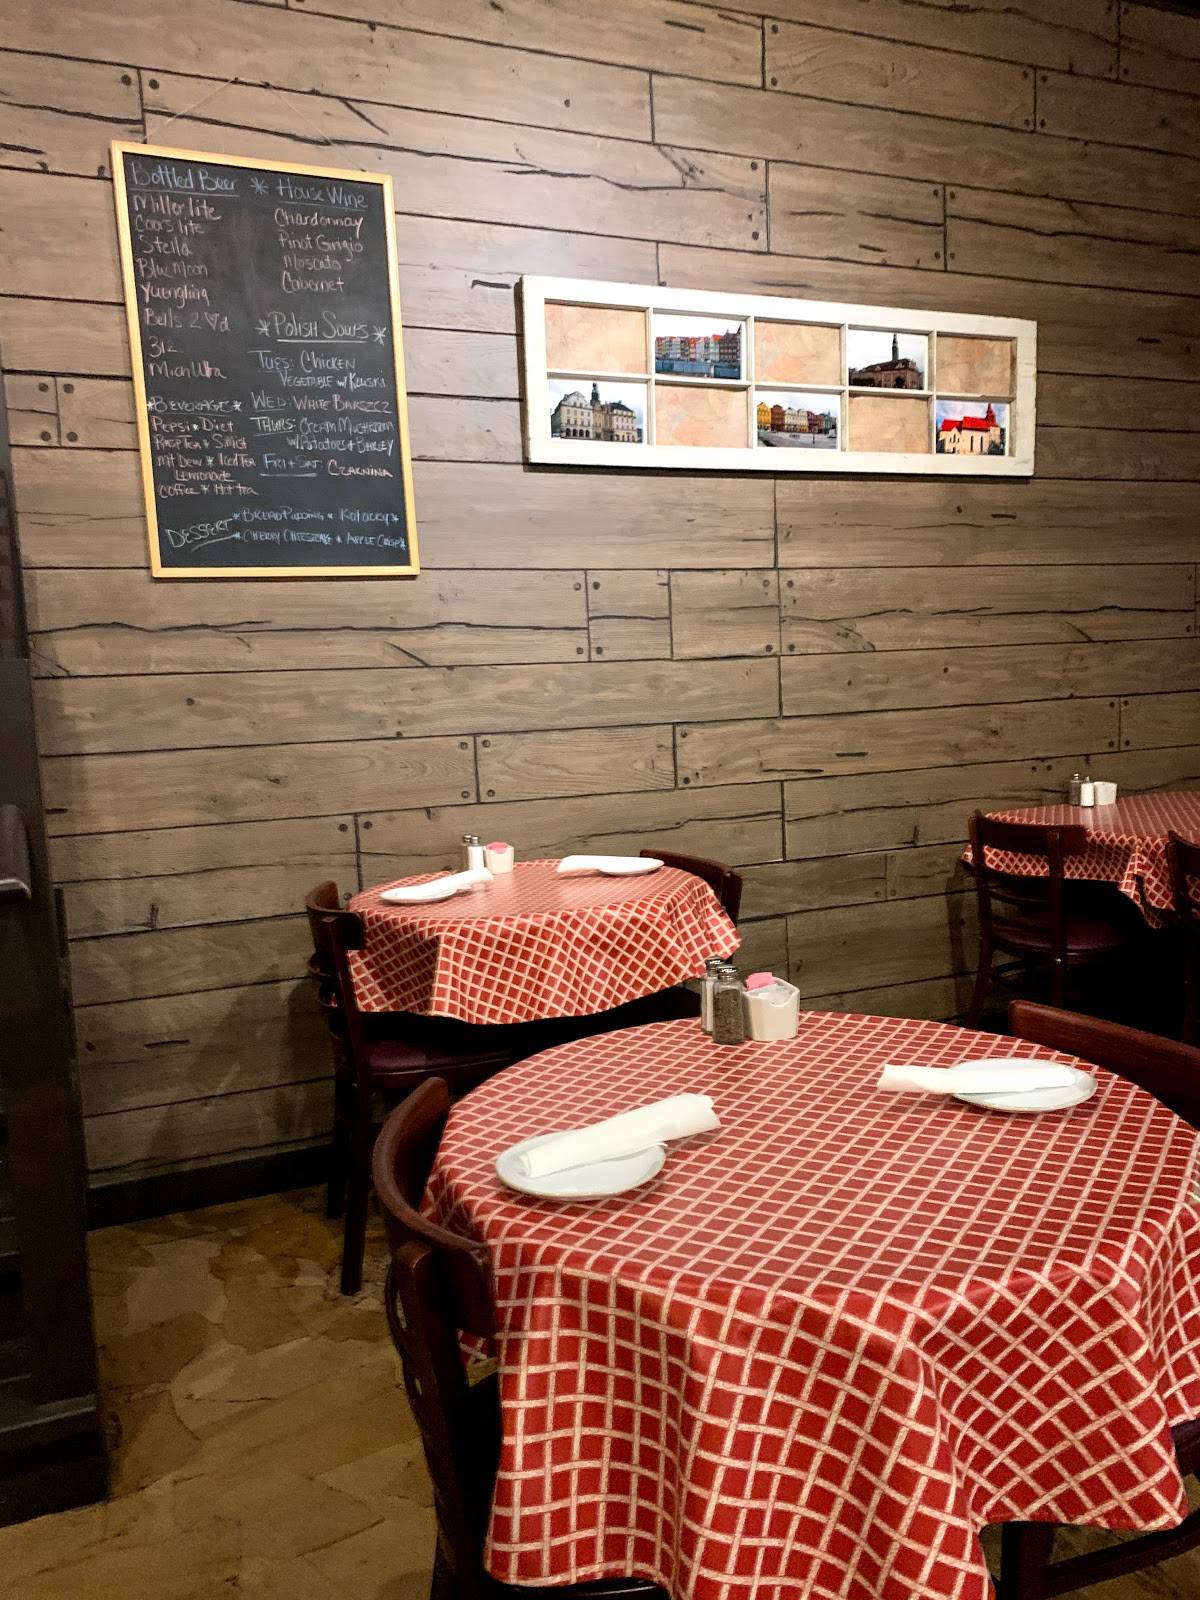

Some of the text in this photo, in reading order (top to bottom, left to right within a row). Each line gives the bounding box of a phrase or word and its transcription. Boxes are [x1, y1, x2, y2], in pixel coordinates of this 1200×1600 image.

[127, 161, 236, 191] Bottled Beer
[326, 186, 369, 209] Wine
[278, 229, 313, 250] Pinot
[281, 270, 345, 294] Cabernet
